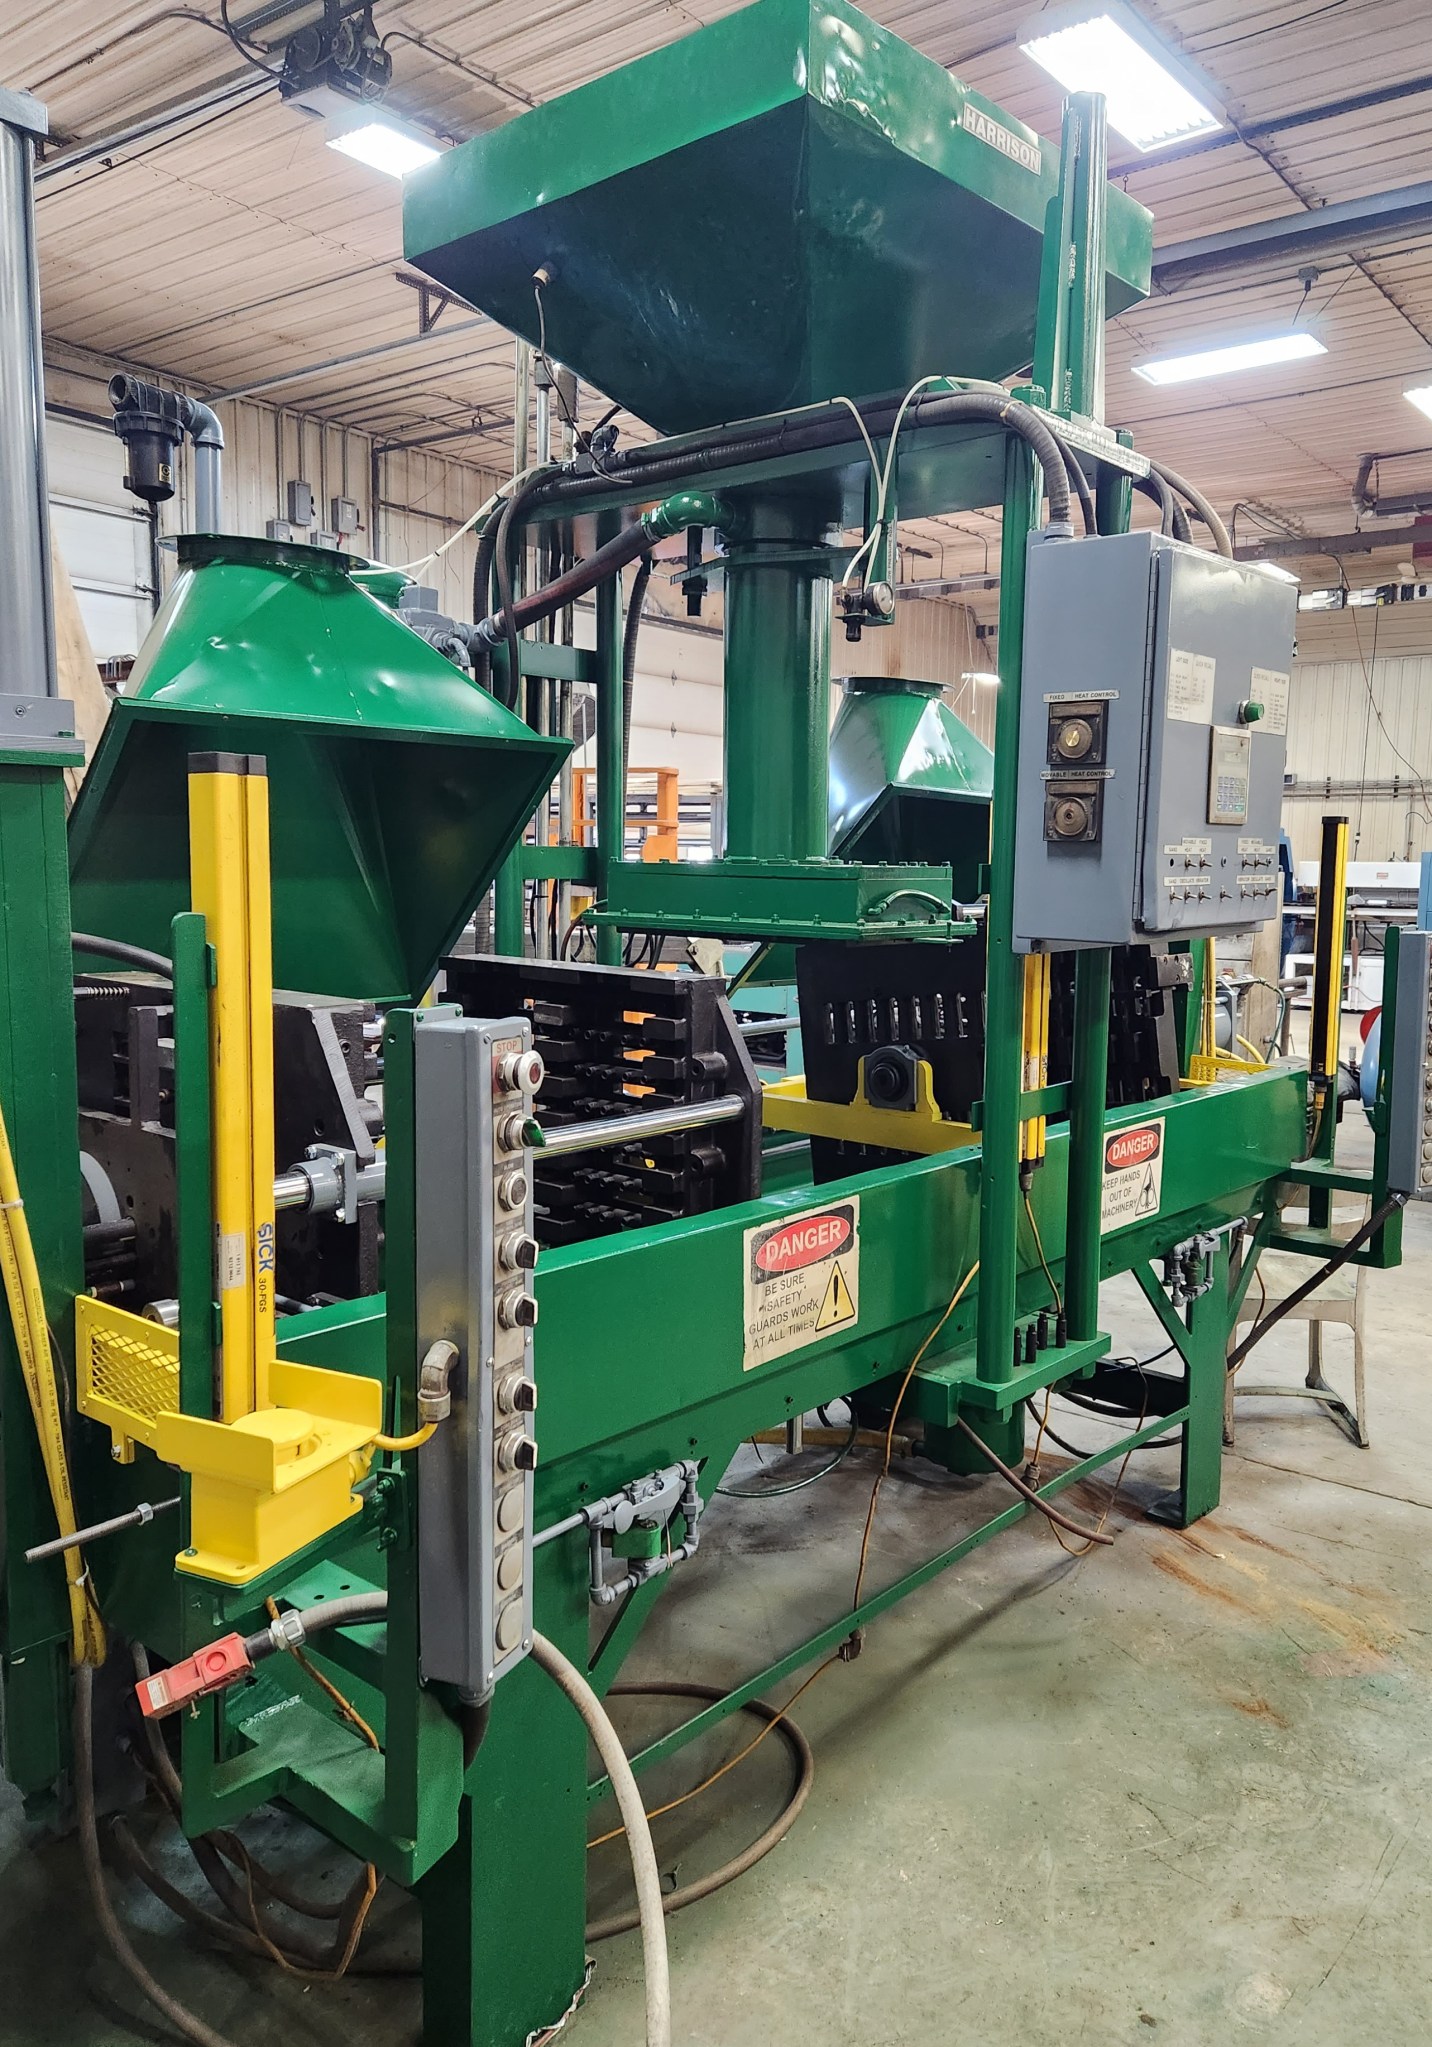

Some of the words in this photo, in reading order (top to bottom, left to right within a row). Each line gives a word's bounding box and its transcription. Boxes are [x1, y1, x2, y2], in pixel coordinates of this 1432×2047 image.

[966, 107, 1039, 172] HARRISON
[496, 1040, 518, 1054] STOP
[1112, 1133, 1154, 1161] DANGER
[1102, 1177, 1118, 1191] KEEP
[1119, 1170, 1140, 1185] HANDS
[1110, 1190, 1122, 1203] OUT
[1123, 1186, 1132, 1197] OF
[1102, 1198, 1137, 1219] MACHINERY
[258, 1223, 274, 1274] SICK
[765, 1219, 842, 1263] DANGER
[259, 1278, 267, 1313] 30-FGS
[765, 1284, 777, 1297] BE
[780, 1273, 805, 1291] SURE
[767, 1289, 802, 1312] SAFETY
[749, 1313, 789, 1336] GUARDS
[791, 1299, 819, 1319] WORK
[752, 1337, 765, 1351] AT
[768, 1330, 785, 1345] ALL
[788, 1318, 815, 1340] TIMES
